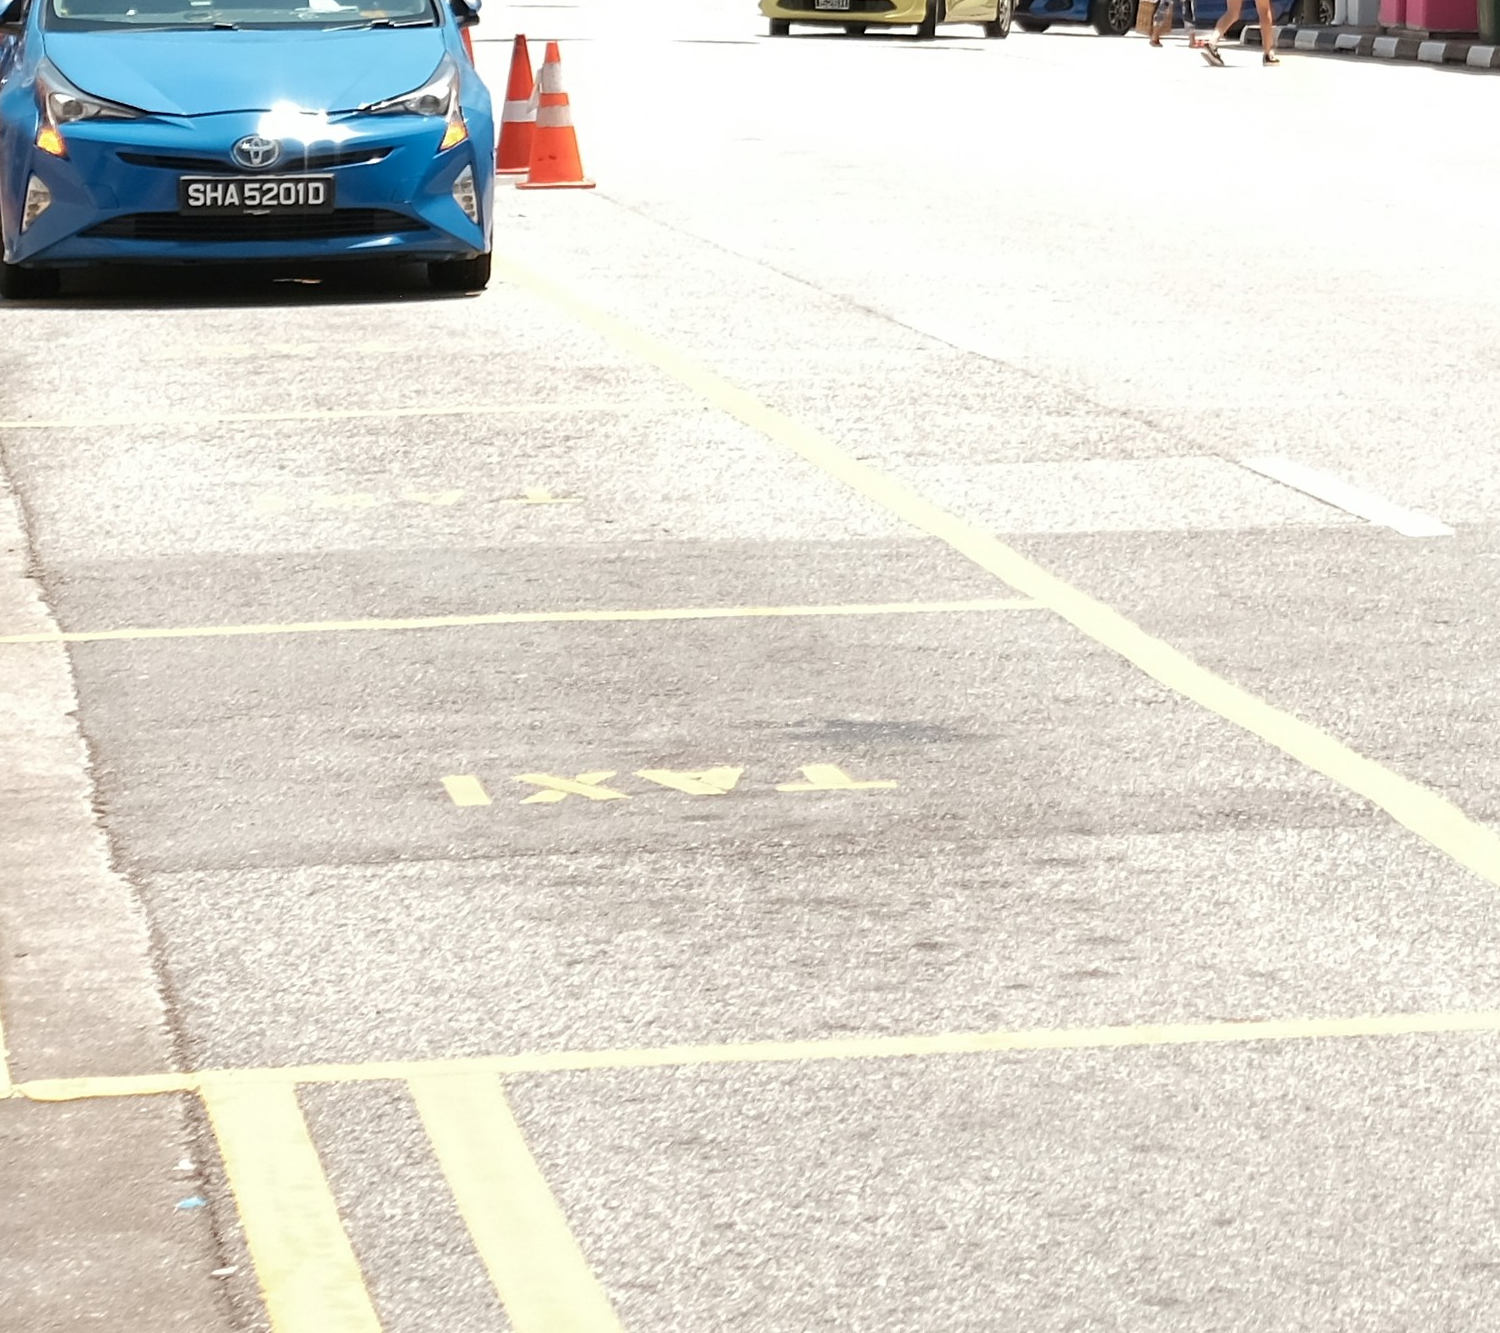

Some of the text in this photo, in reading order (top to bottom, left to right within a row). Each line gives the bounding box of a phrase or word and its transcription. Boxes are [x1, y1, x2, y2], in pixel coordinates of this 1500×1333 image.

[187, 182, 325, 207] SHA 5201D
[440, 763, 898, 806] TAXI
